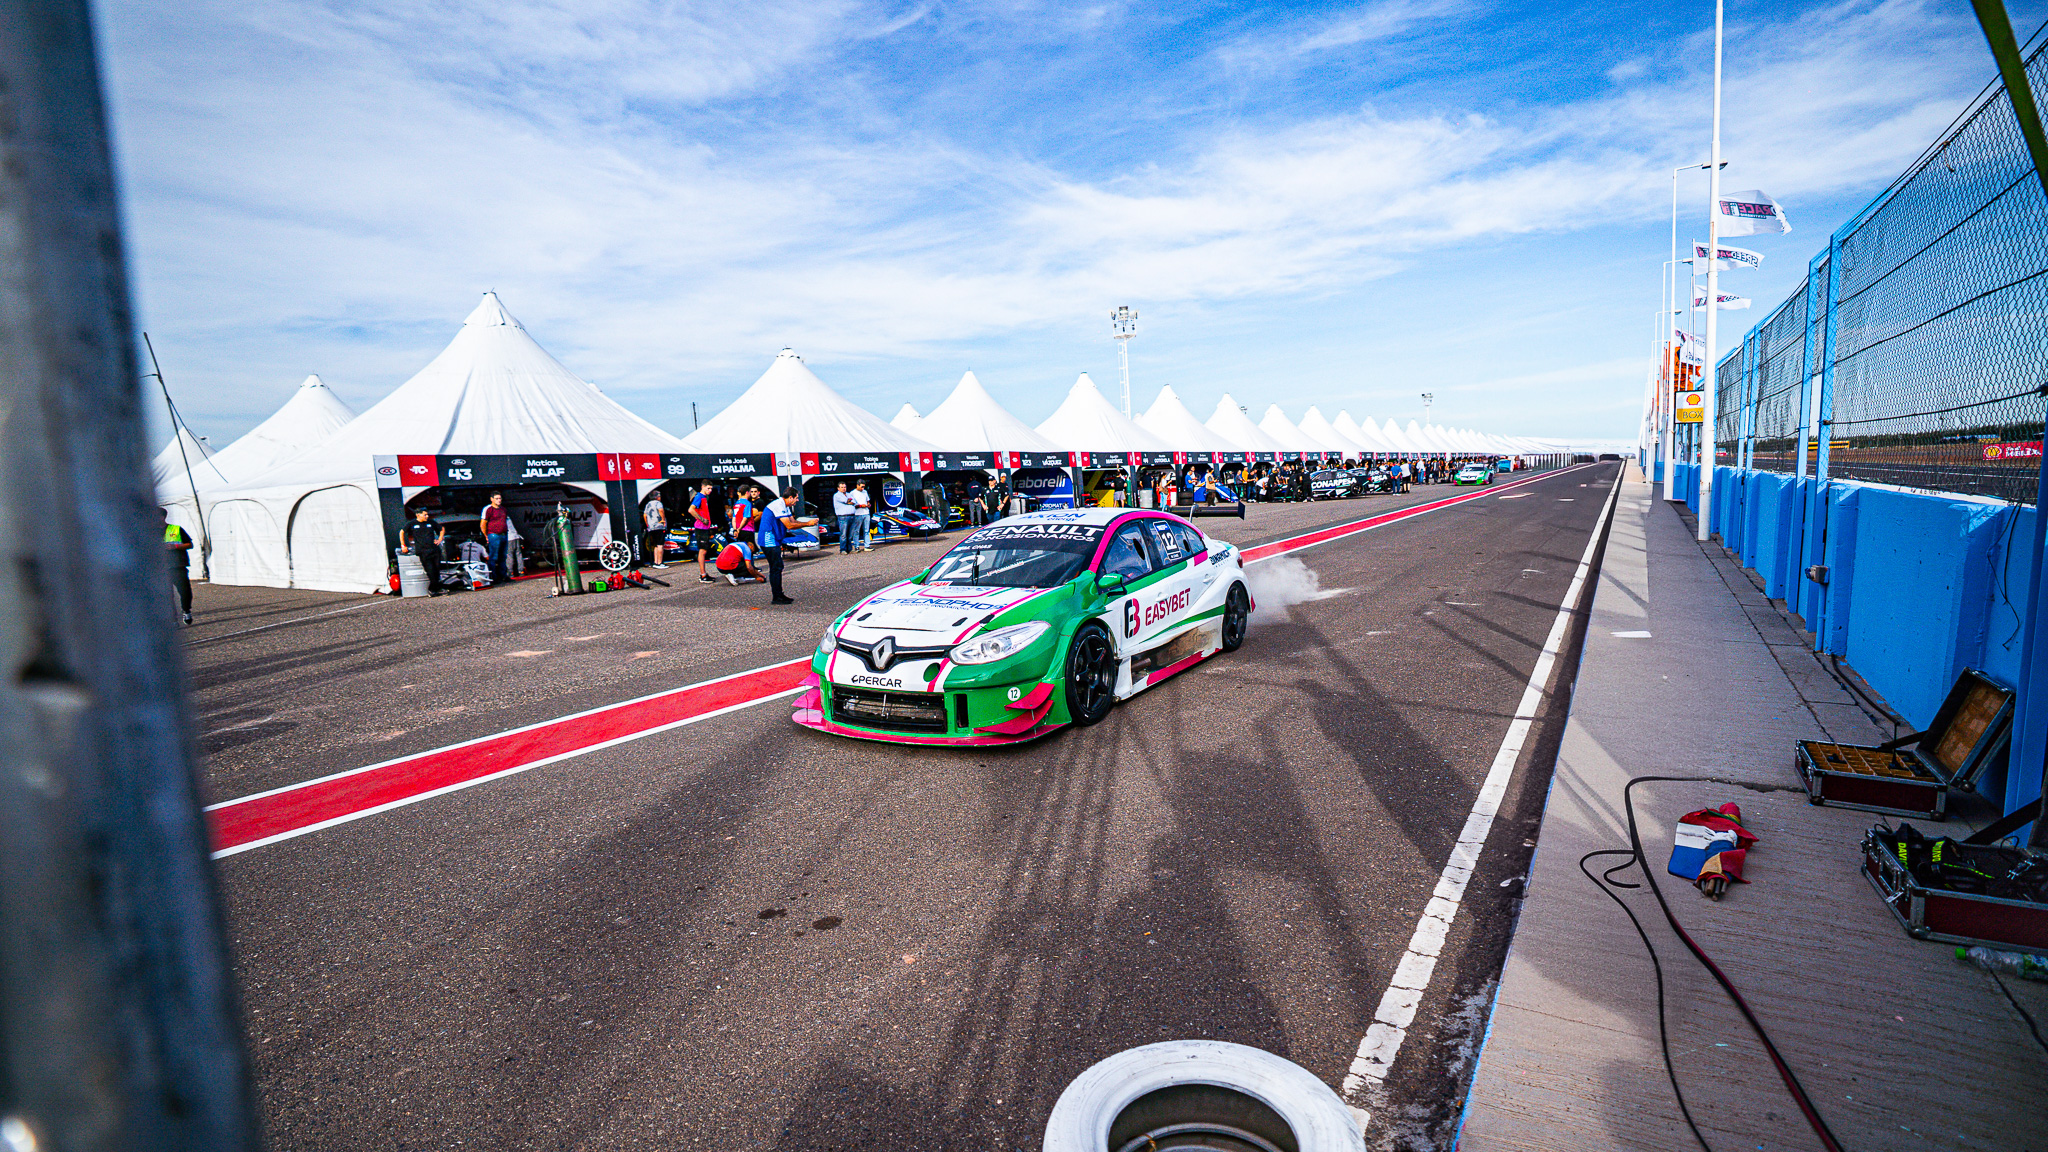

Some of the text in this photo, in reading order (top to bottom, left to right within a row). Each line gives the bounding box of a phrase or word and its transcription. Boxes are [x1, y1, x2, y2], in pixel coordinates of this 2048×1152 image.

[1683, 410, 1703, 419] BOX
[667, 464, 685, 475] 99
[712, 464, 756, 474] DI PALMA
[822, 462, 838, 471] 107
[448, 468, 473, 480] 43
[522, 467, 565, 478] JALAF
[1311, 477, 1357, 489] CONARPESA
[969, 524, 1104, 540] RENAULT
[964, 533, 1096, 544] CONCESIONARIOS
[1161, 532, 1178, 551] 12
[929, 554, 986, 581] 12
[1145, 587, 1191, 627] EASYBET
[1010, 688, 1018, 699] 12
